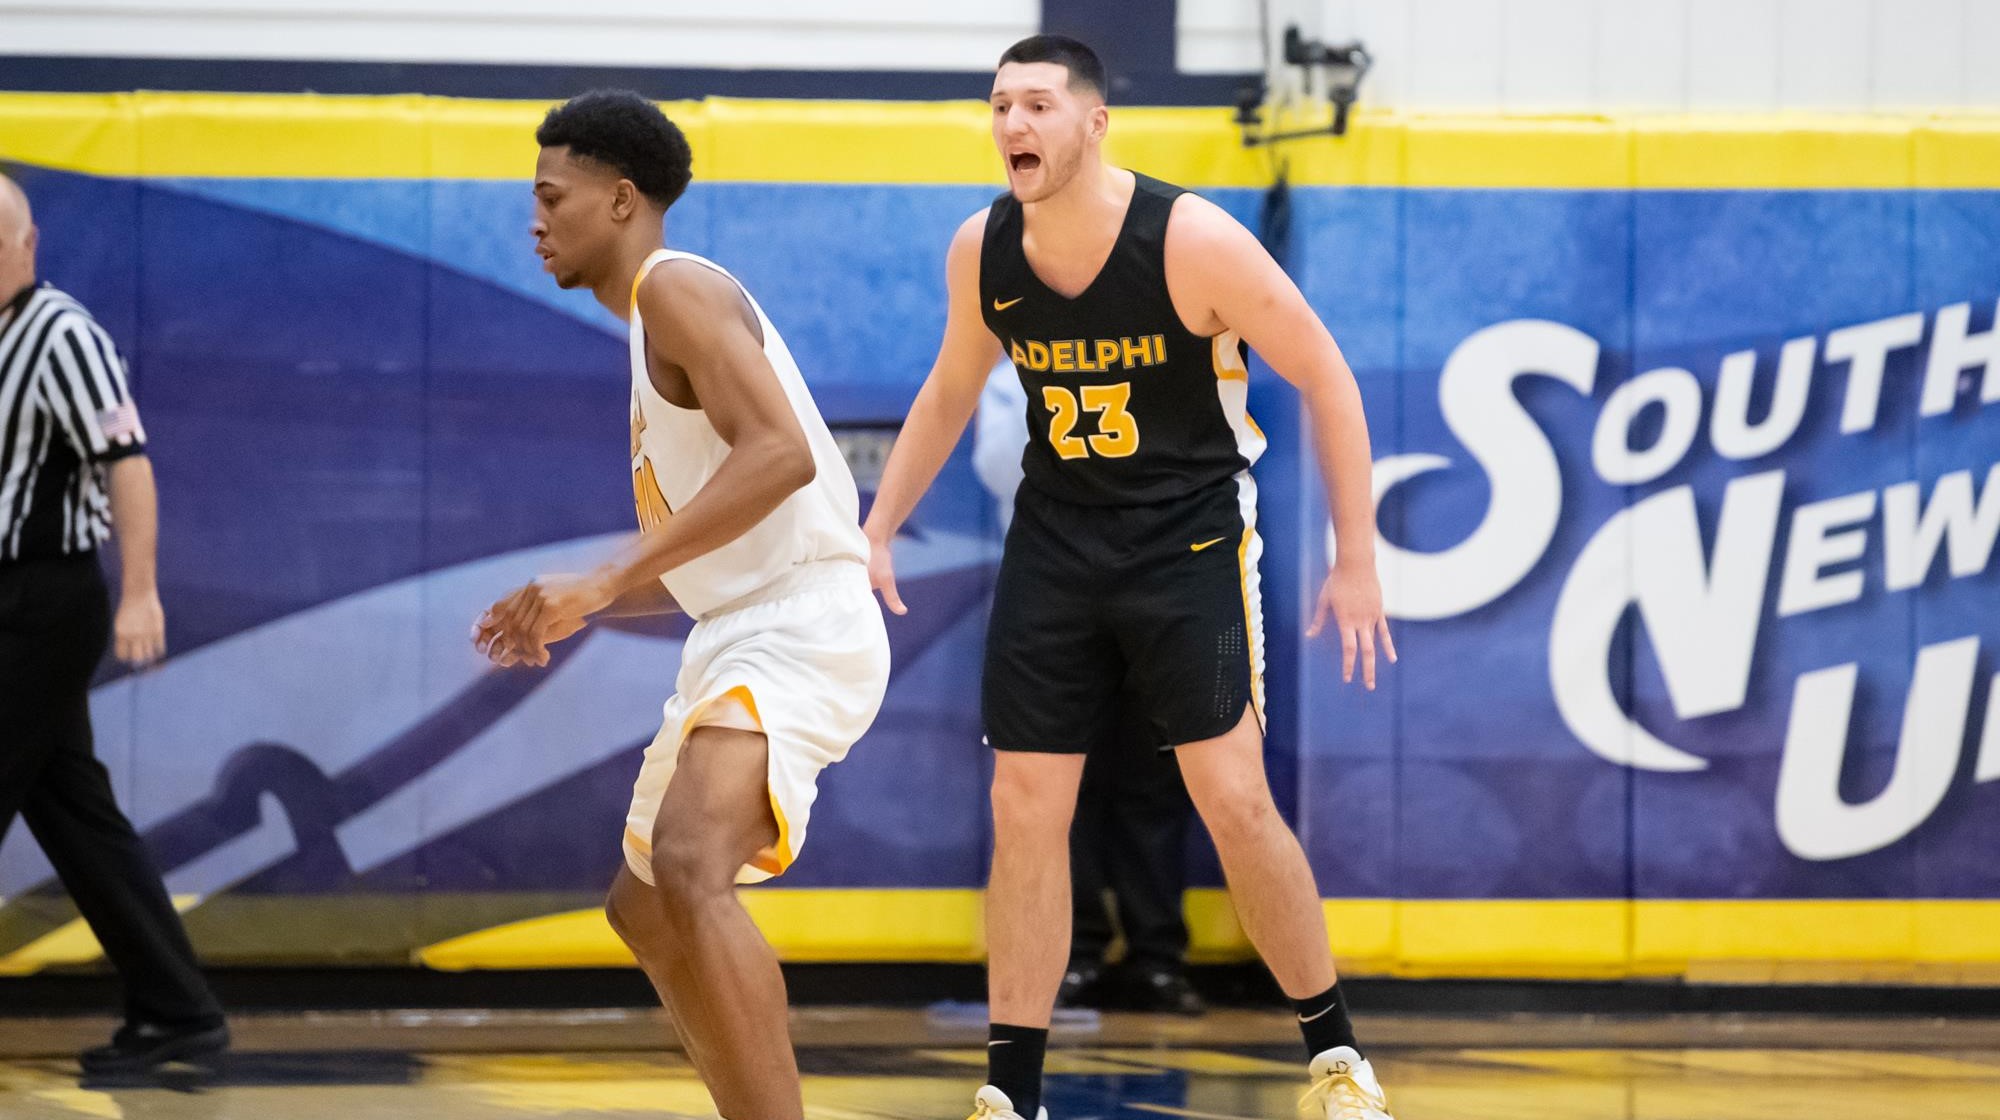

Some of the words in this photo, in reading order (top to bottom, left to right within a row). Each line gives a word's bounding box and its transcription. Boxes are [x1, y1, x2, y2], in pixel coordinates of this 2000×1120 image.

[1011, 333, 1168, 373] ADELPHI
[1042, 381, 1140, 460] 23
[1326, 296, 2000, 620] SOUTH
[1548, 462, 2000, 772] NEW
[1775, 636, 2000, 861] U
